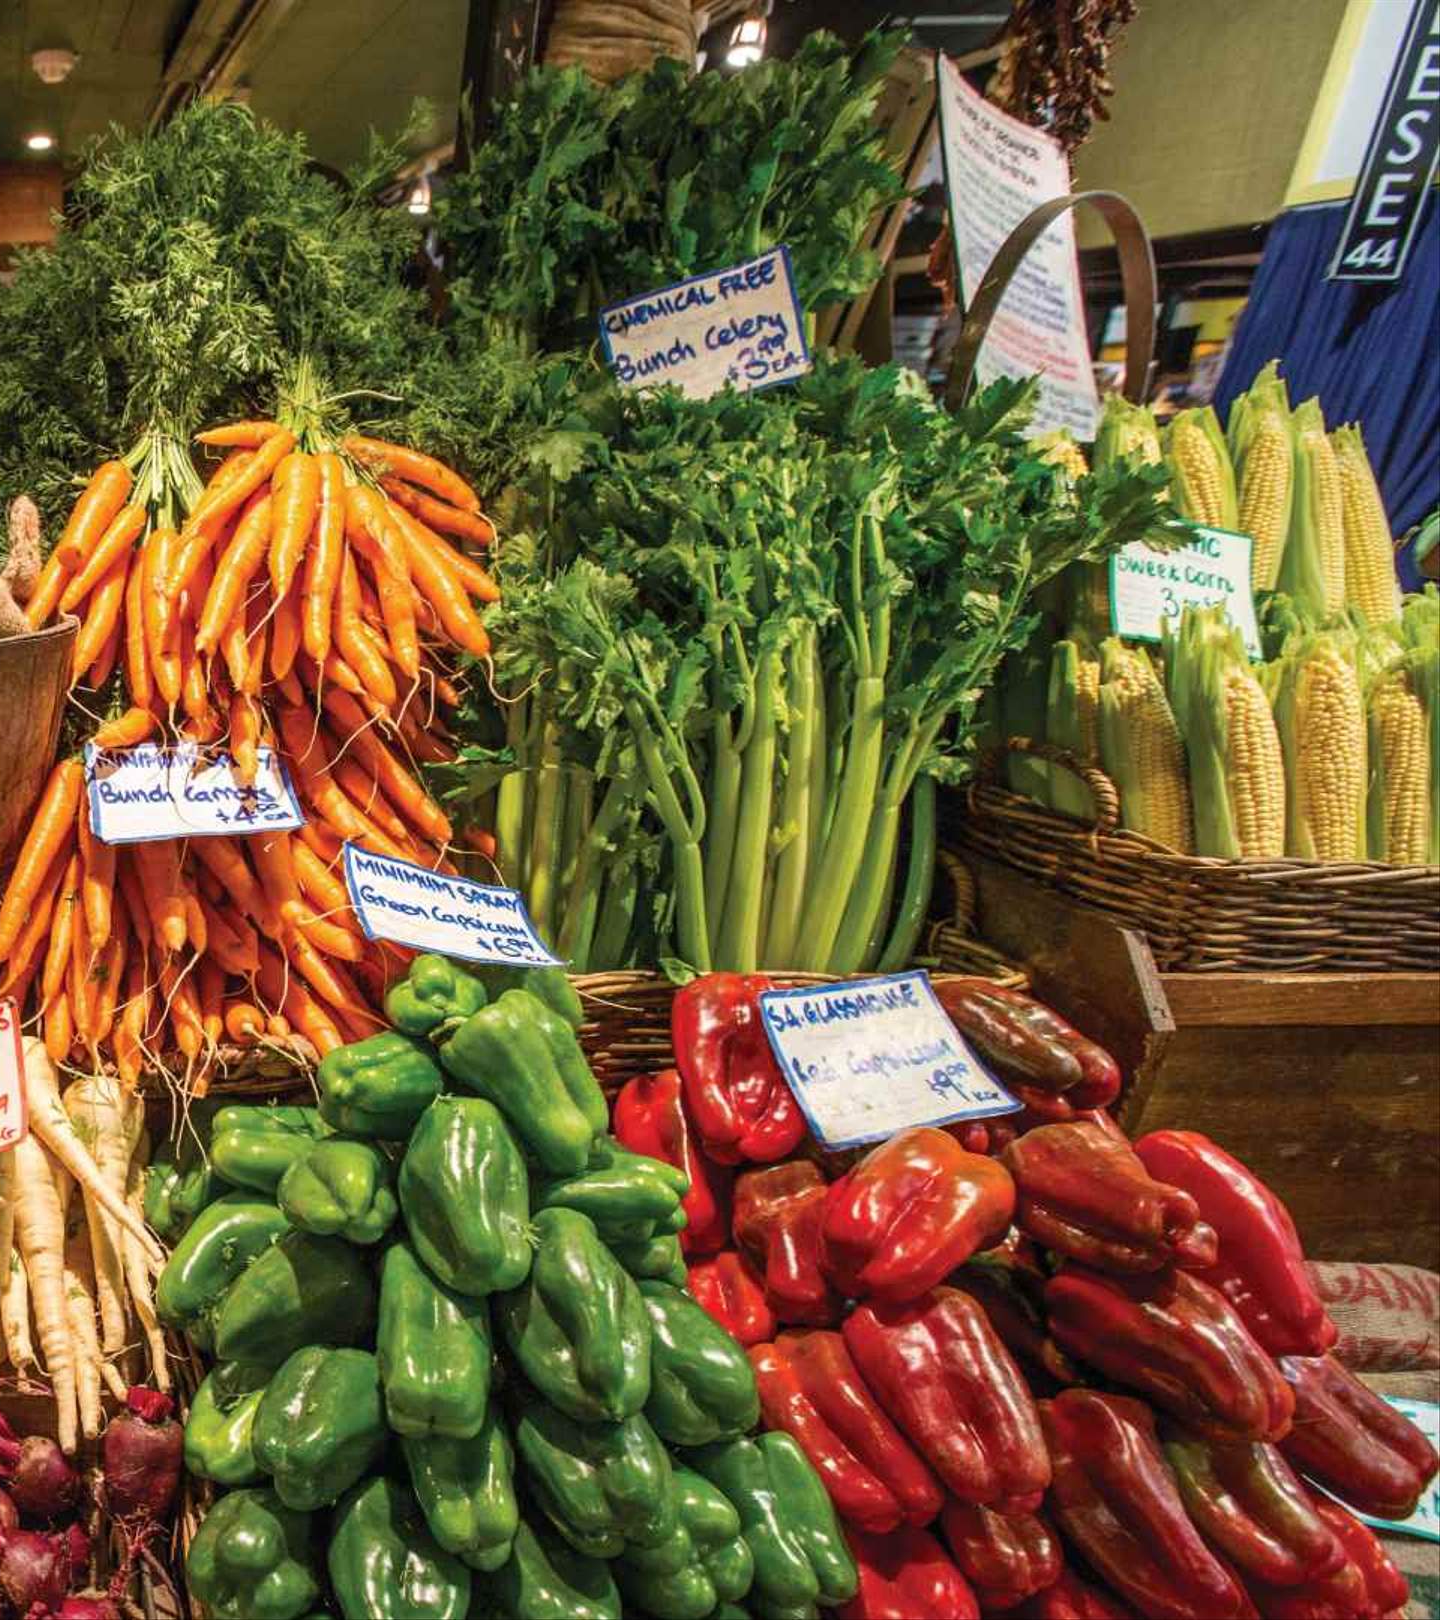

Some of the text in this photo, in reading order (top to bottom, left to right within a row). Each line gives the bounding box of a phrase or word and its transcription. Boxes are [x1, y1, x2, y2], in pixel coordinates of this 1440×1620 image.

[1343, 238, 1397, 269] 44
[606, 258, 777, 336] CHEMICAL FREE
[616, 313, 788, 382] Bunch Celery
[1185, 565, 1235, 593] Corn
[98, 783, 277, 805] Bunch Carrots
[355, 856, 519, 912] MINIMUM SPRAY
[360, 885, 528, 939] Green Capsicum
